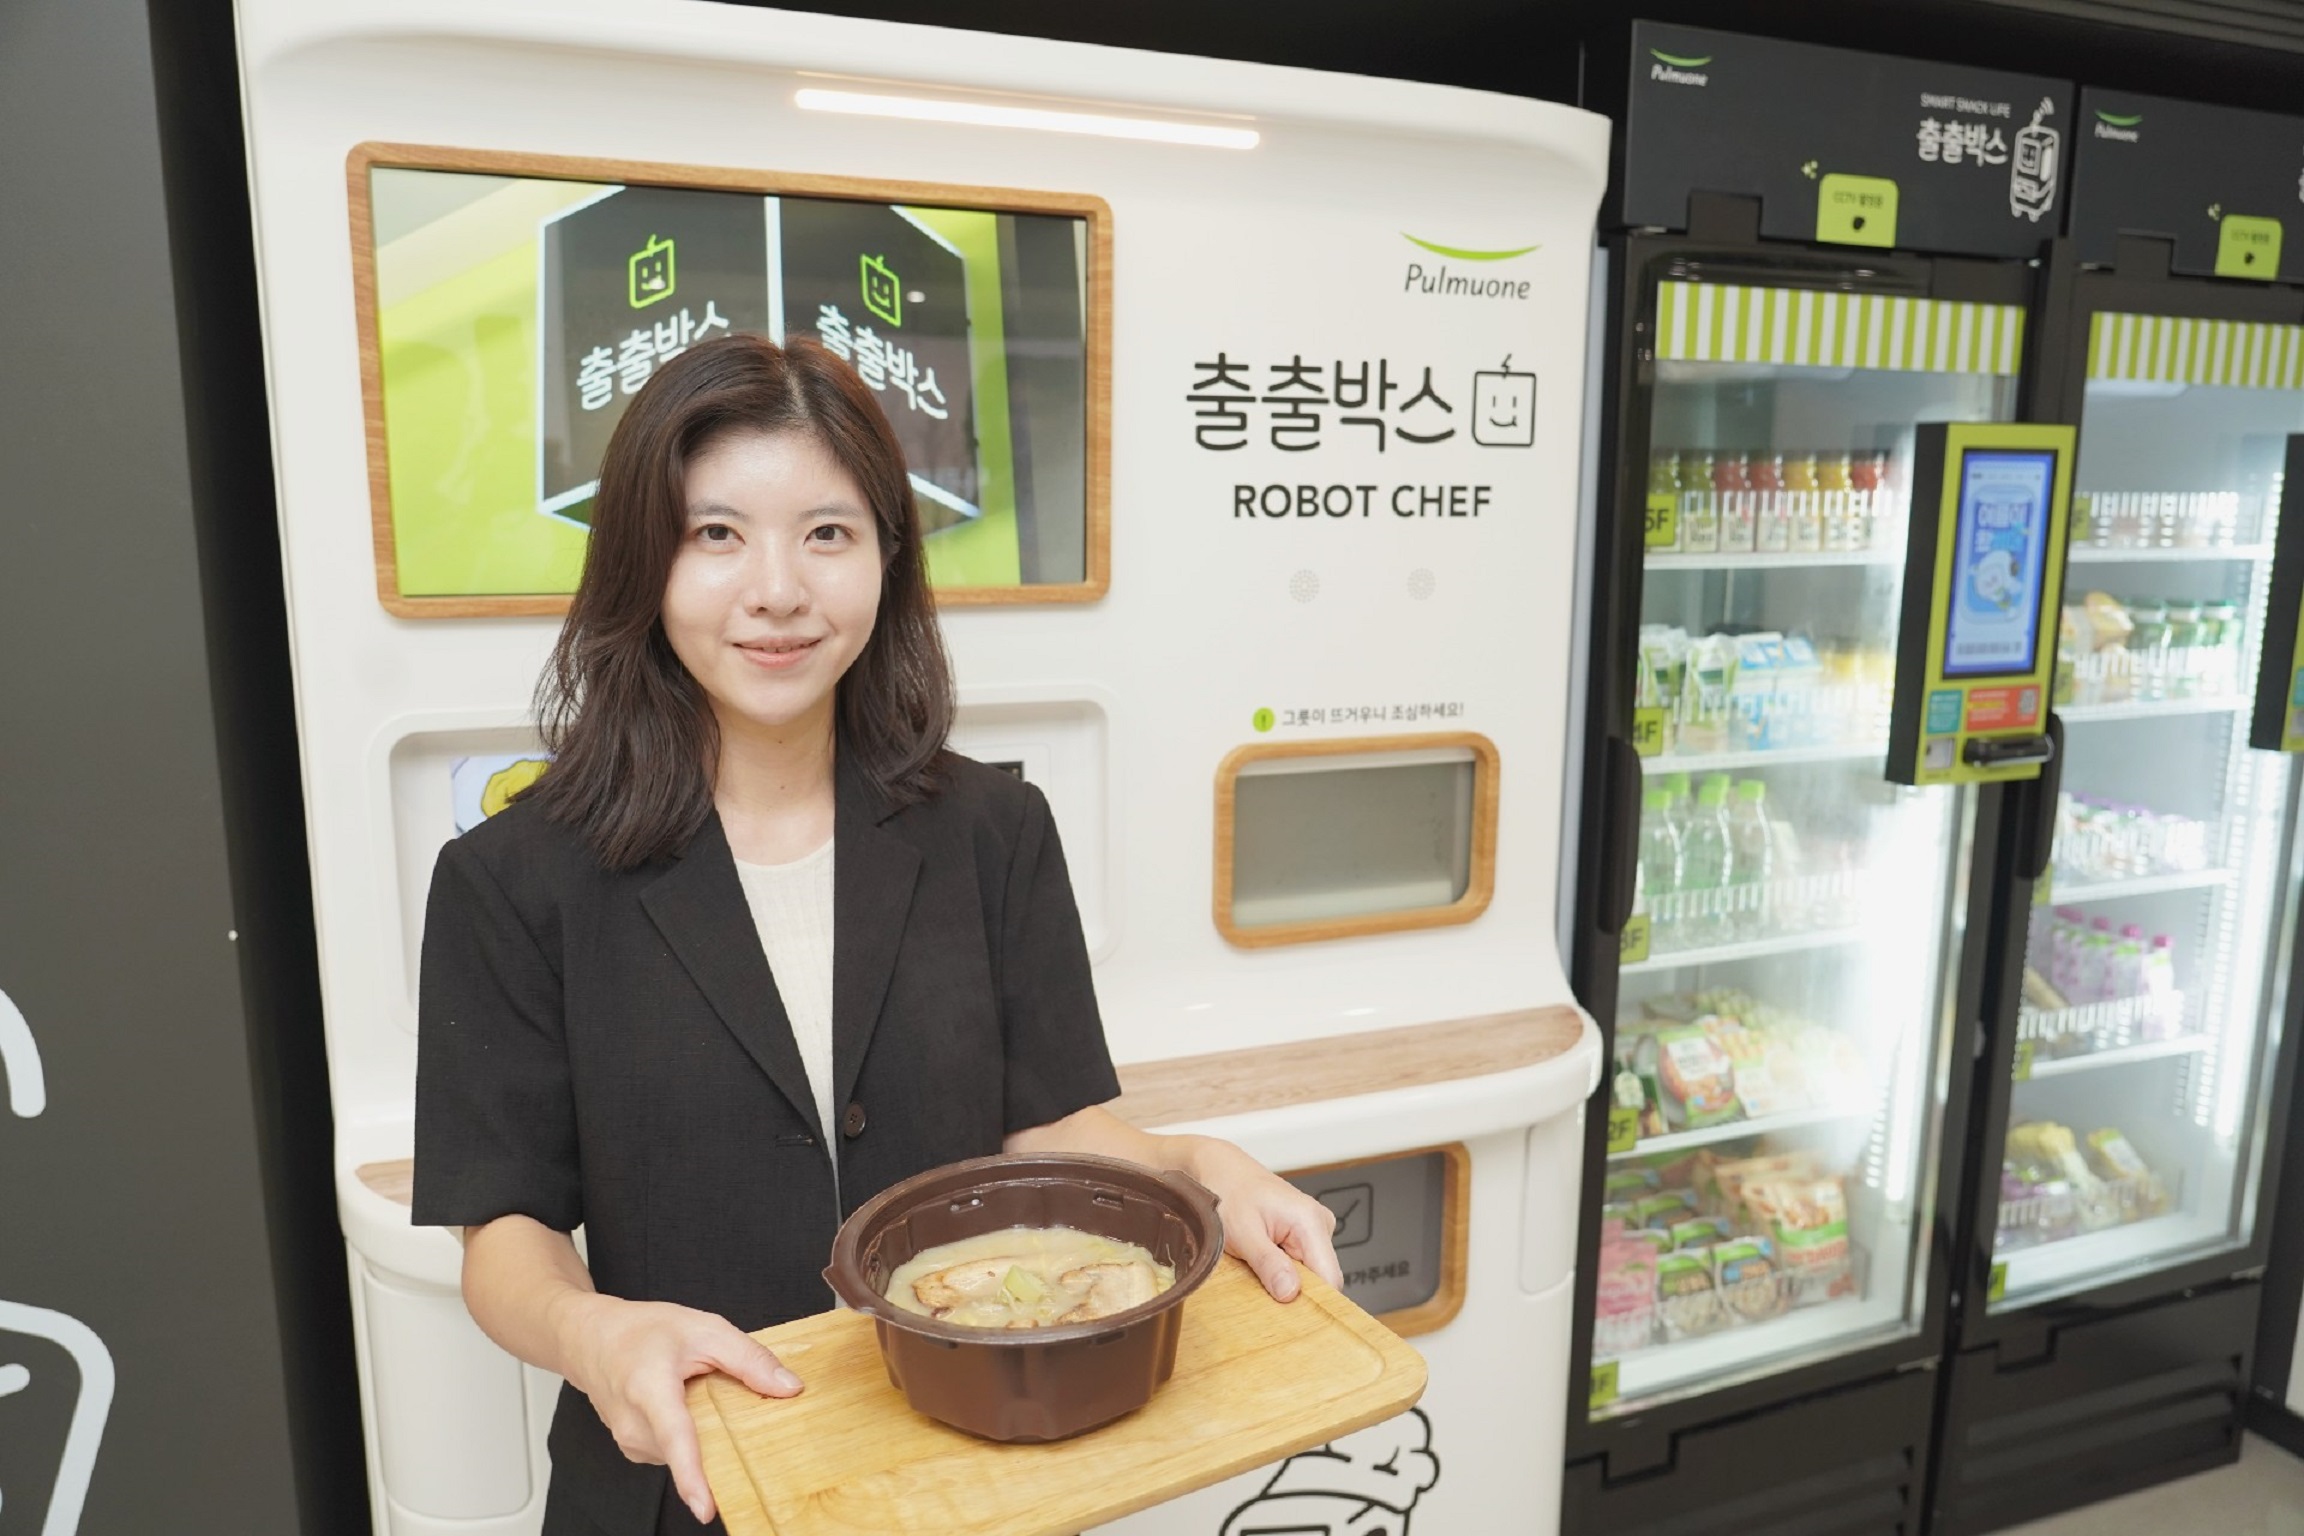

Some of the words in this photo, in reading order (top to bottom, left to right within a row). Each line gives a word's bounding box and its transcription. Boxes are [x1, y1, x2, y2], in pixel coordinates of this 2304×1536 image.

[1916, 116, 2009, 167] 출출박스
[1404, 263, 1531, 300] Pulmuone
[816, 304, 949, 420] 출출박스
[1186, 352, 1456, 453] 출출박스
[1233, 484, 1378, 518] ROBOT
[1391, 485, 1493, 518] CHEF
[1282, 708, 1326, 727] 그릇이
[1330, 705, 1387, 725] 뜨거우니
[1391, 702, 1465, 722] 조심하세요!
